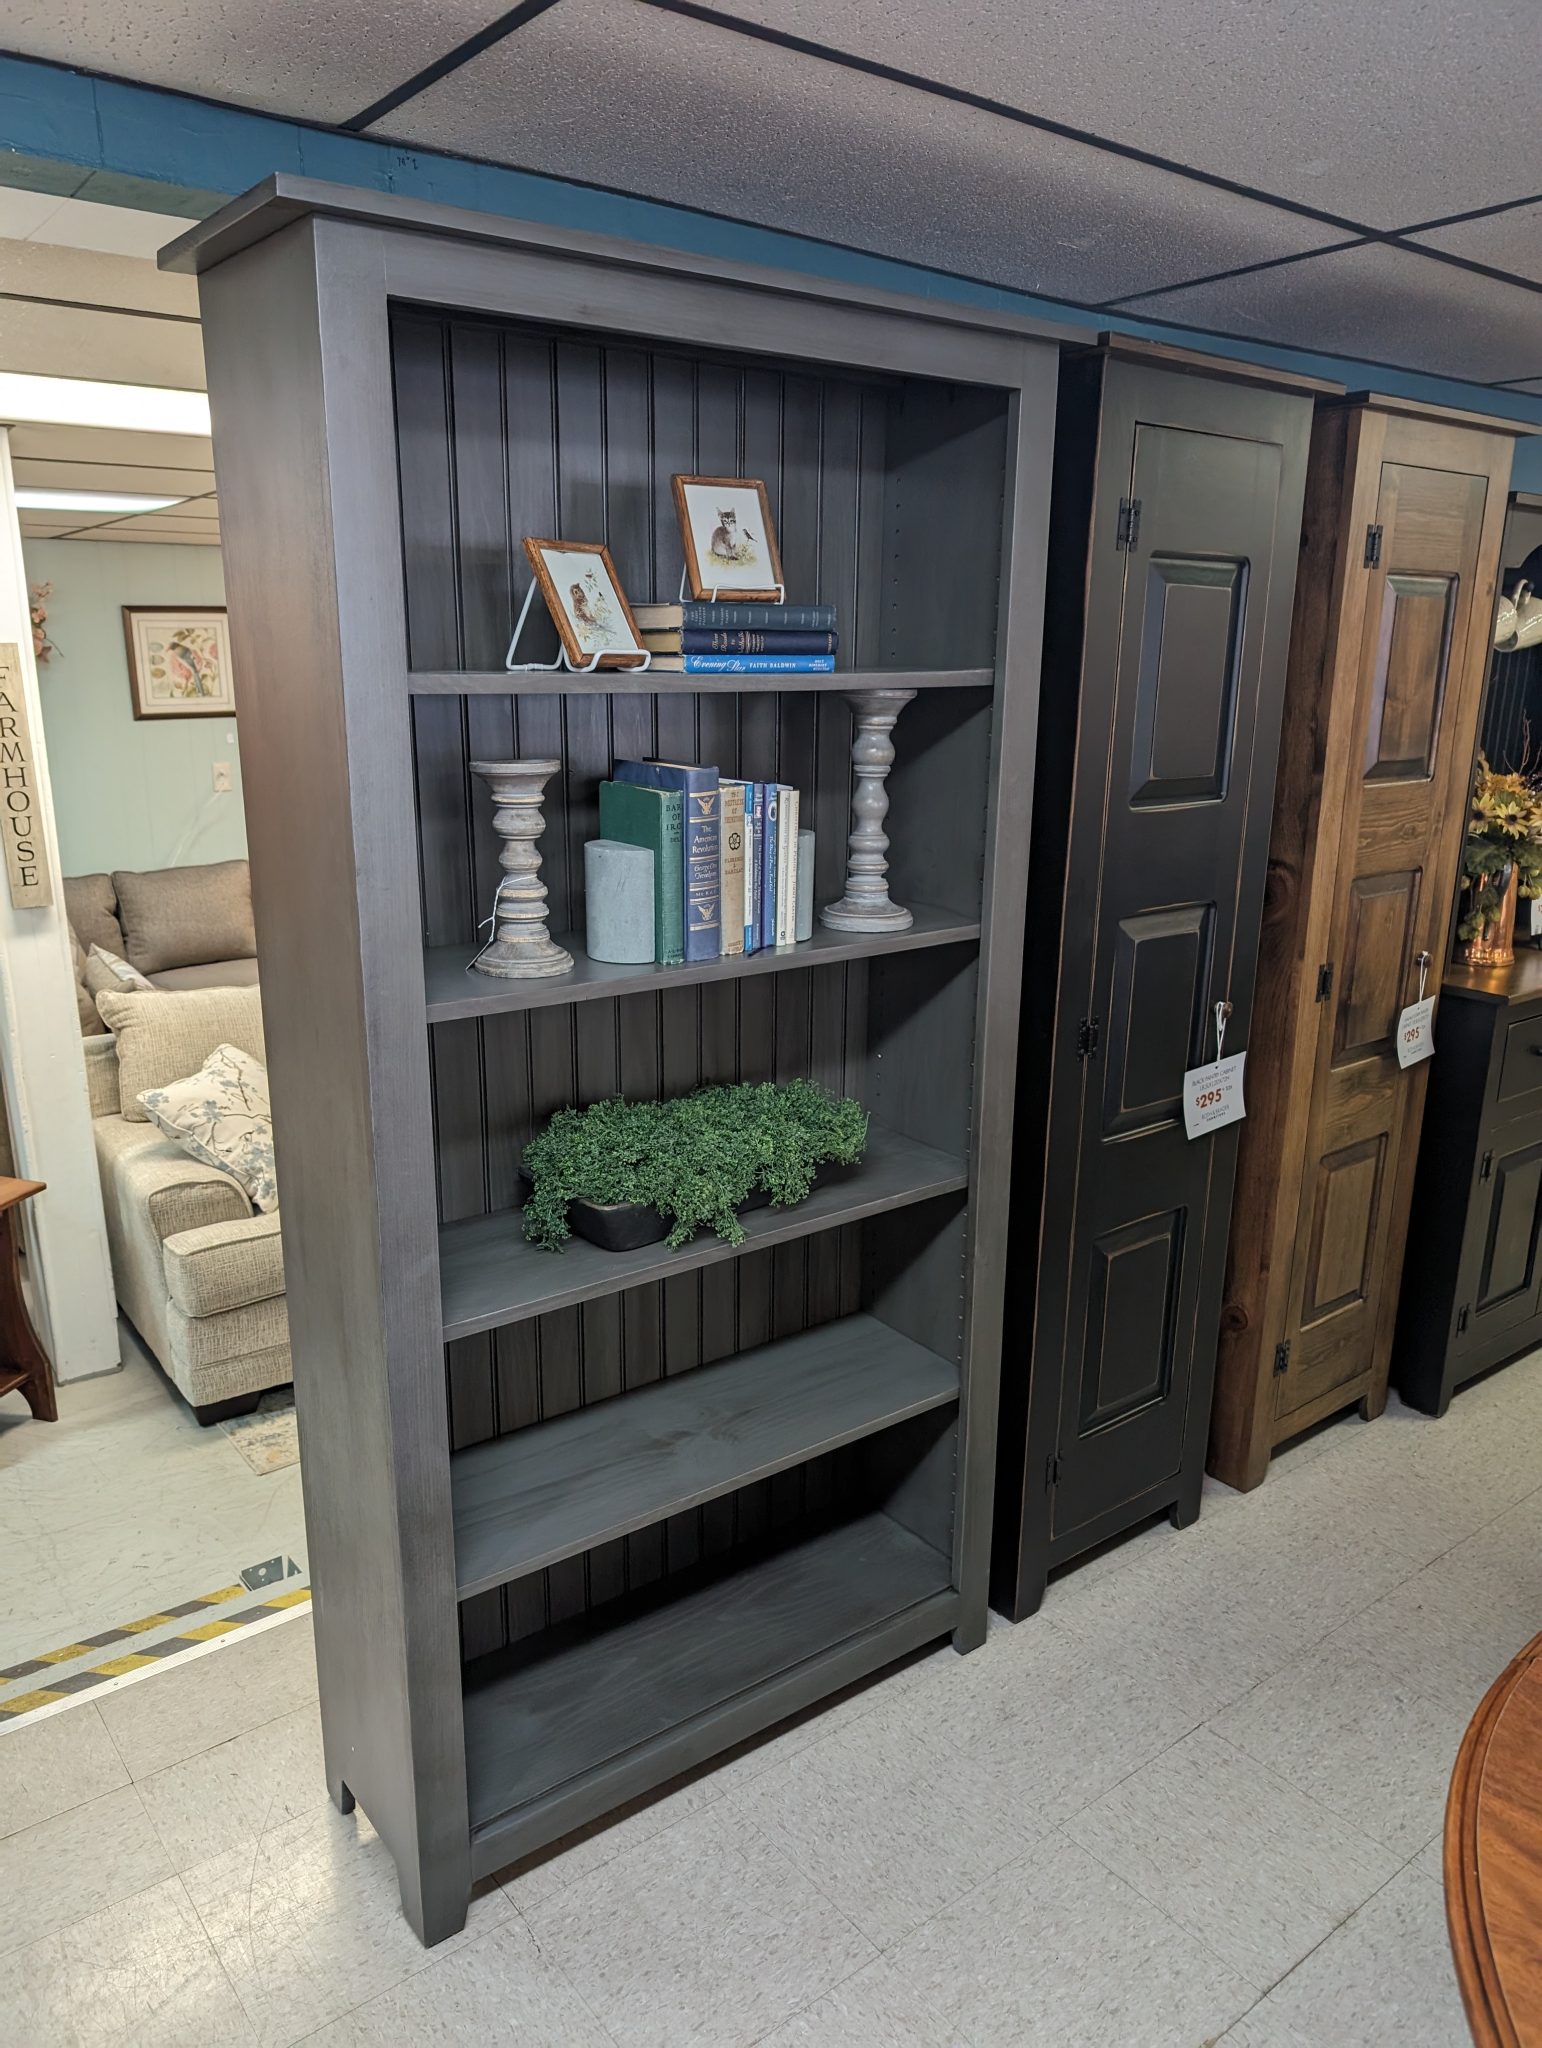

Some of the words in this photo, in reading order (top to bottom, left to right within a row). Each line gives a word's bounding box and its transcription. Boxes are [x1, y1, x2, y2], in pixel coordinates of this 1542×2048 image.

[690, 656, 727, 672] Evening
[727, 660, 746, 672] Star
[665, 804, 682, 812] BAR
[666, 822, 681, 831] IRO
[702, 825, 712, 833] The
[693, 834, 718, 844] American
[692, 844, 719, 854] Revolution
[1404, 1027, 1420, 1043] $295
[1195, 1088, 1222, 1109] $295
